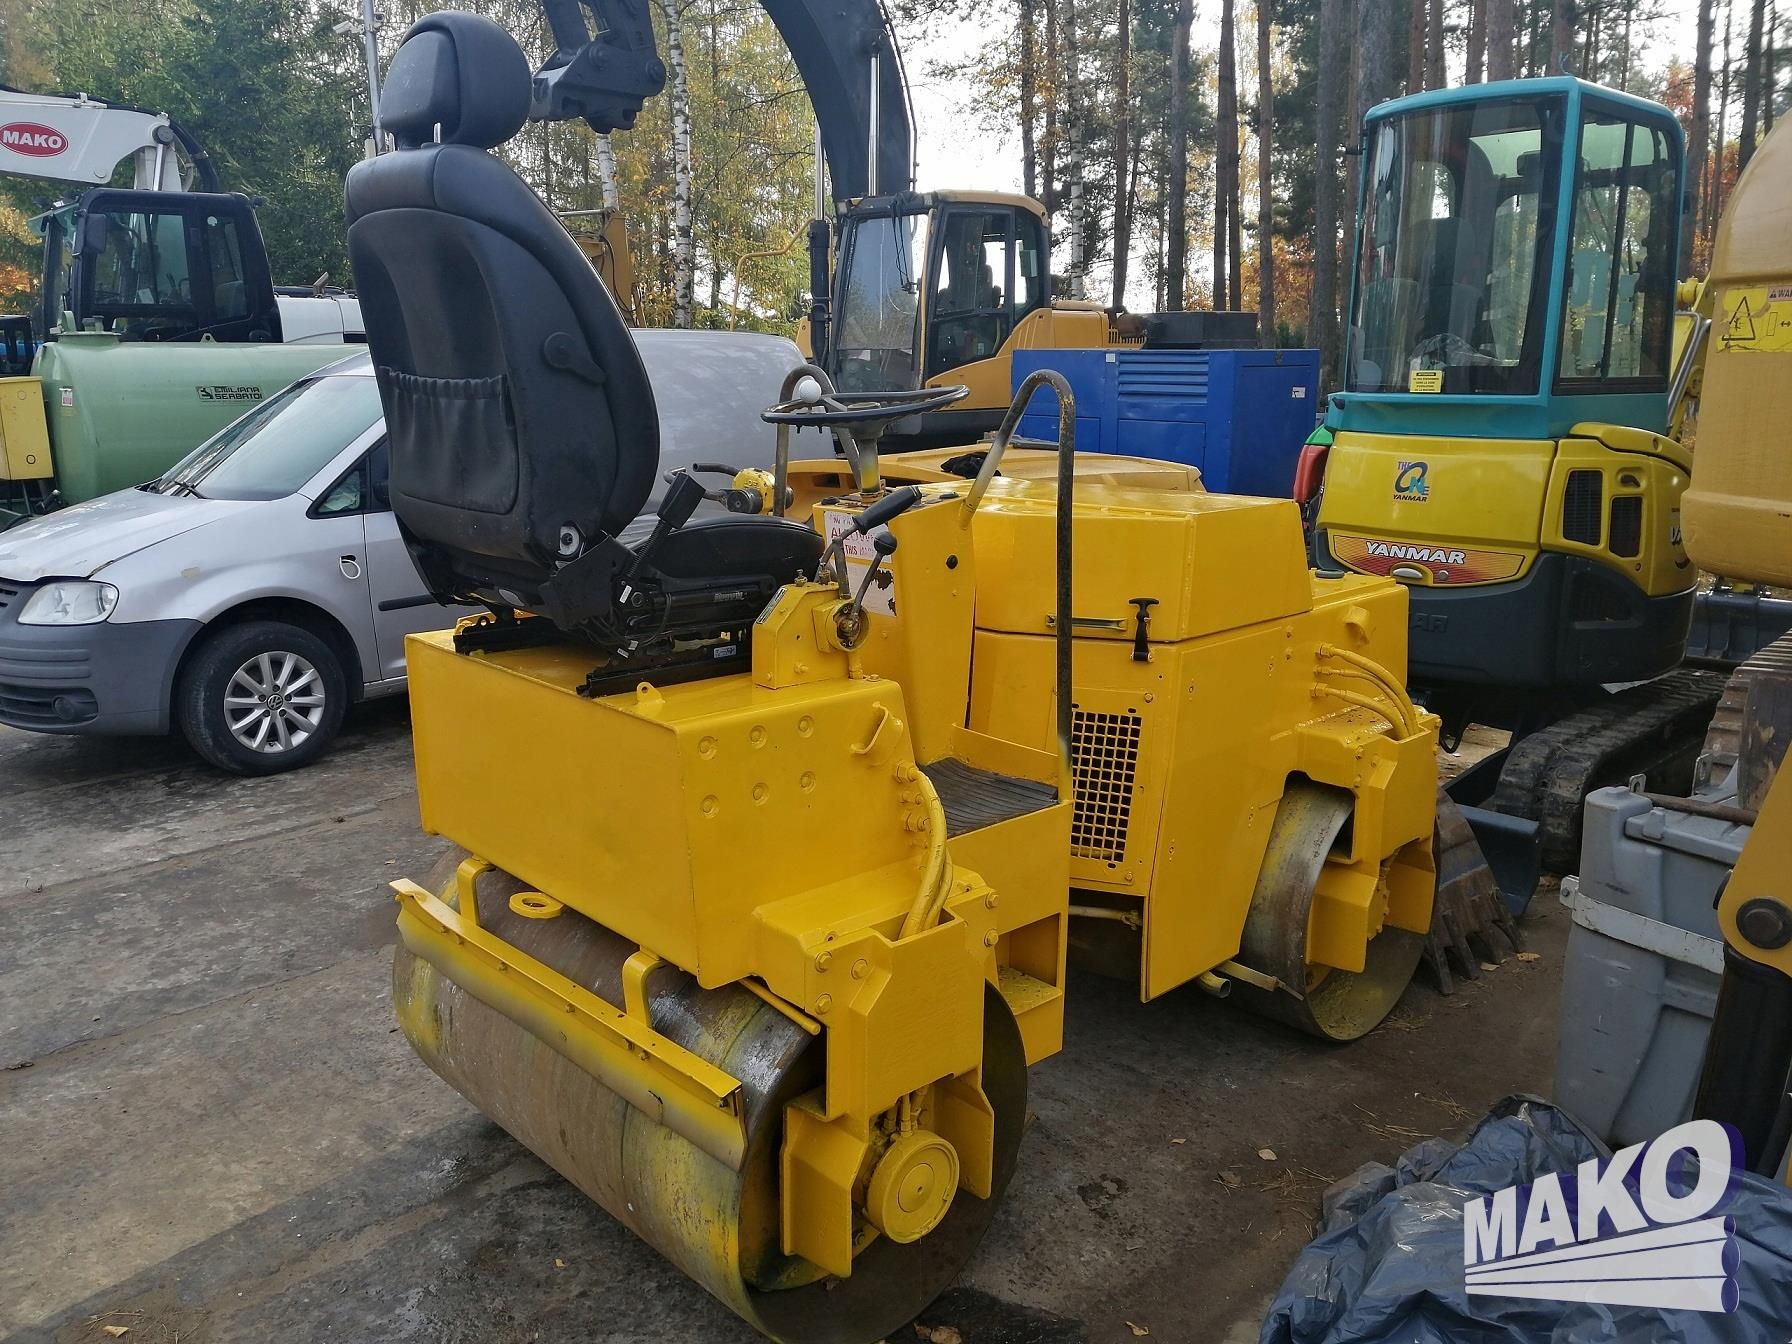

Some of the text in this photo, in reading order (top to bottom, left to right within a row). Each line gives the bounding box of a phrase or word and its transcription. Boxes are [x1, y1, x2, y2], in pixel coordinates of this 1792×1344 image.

[3, 130, 62, 149] MAKO
[1778, 288, 1792, 298] WA
[1393, 494, 1428, 502] YANMAR
[1366, 541, 1466, 564] YANMAR
